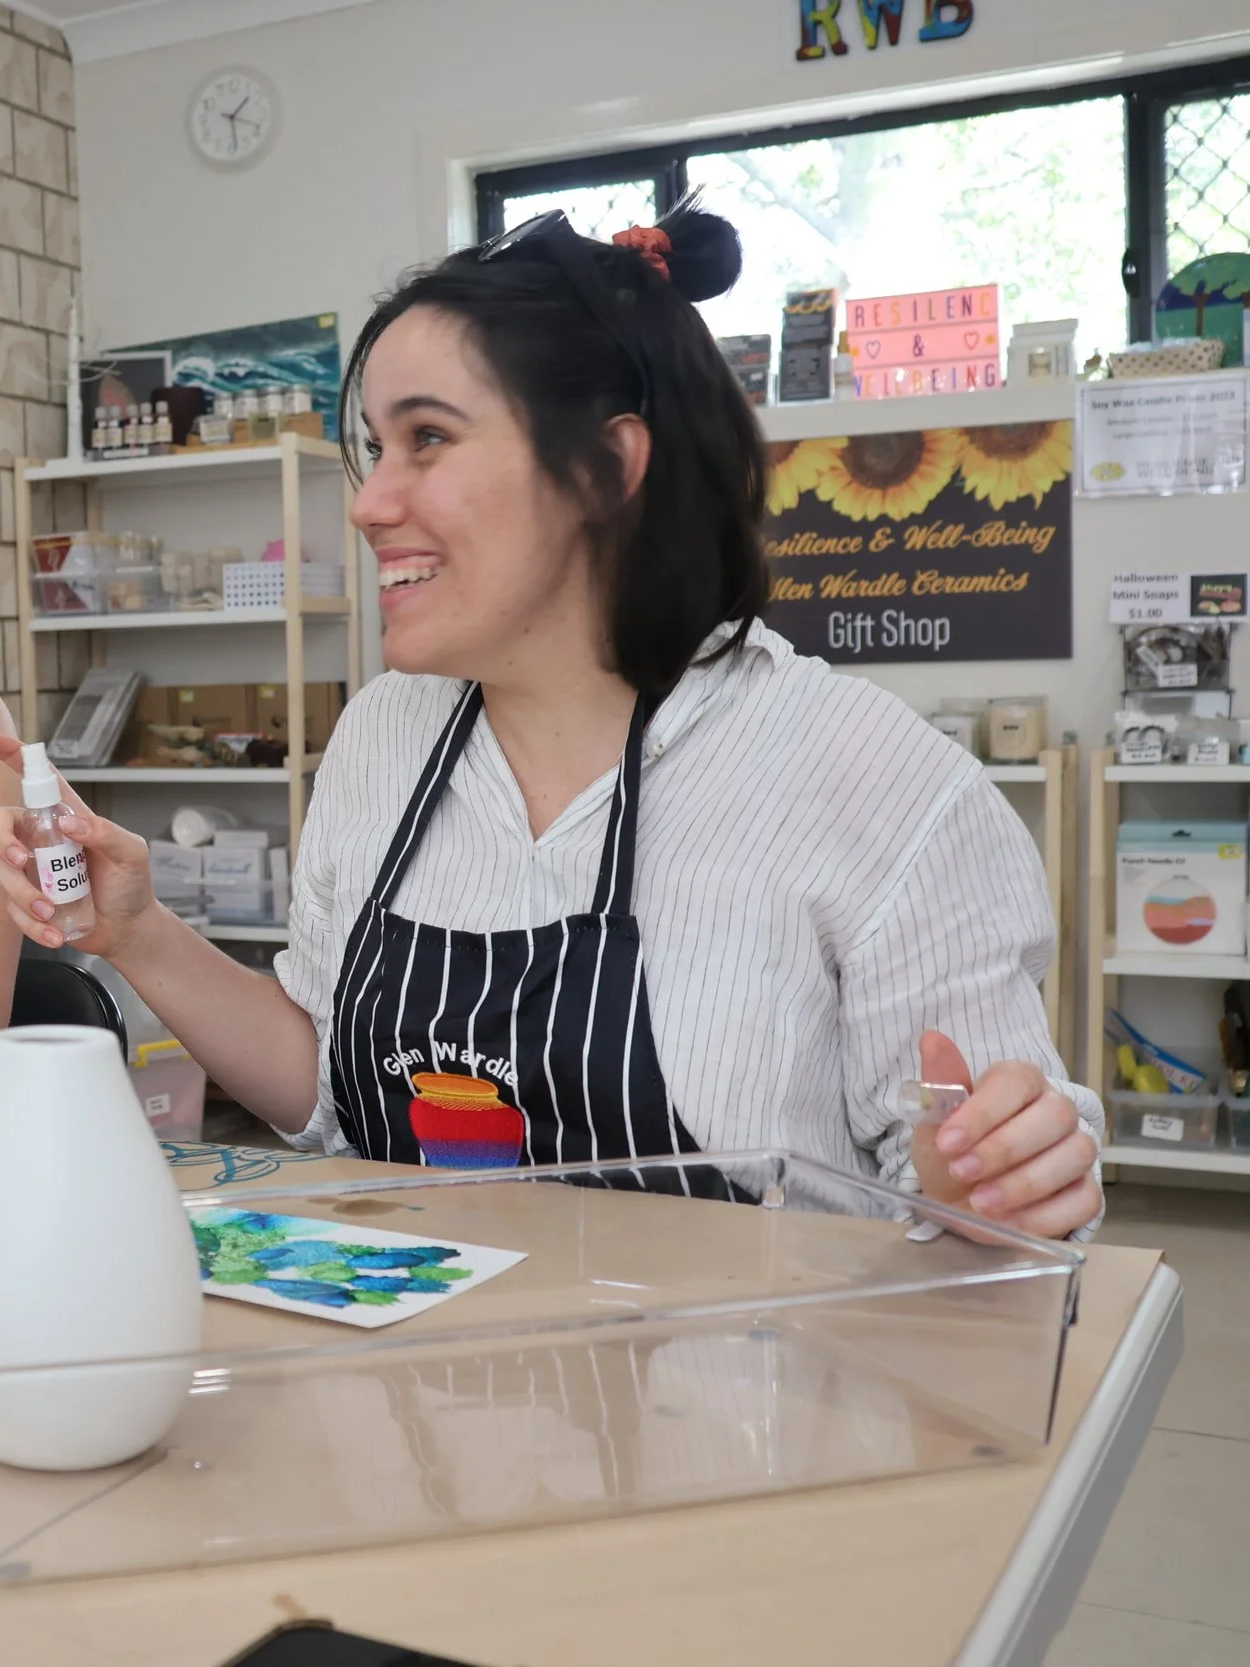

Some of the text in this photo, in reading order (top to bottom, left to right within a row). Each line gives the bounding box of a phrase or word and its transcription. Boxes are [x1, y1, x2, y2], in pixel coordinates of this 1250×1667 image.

[913, 334, 924, 357] &
[765, 520, 1056, 557] esilience & Well-Being
[819, 570, 908, 600] Wardle
[911, 568, 1030, 596] Ceramics
[1113, 589, 1179, 601] Mini Soaps
[828, 609, 950, 653] Gift Shop
[50, 846, 86, 872] Blen
[57, 871, 88, 892] Solu
[383, 1041, 518, 1086] Glen Wardle
